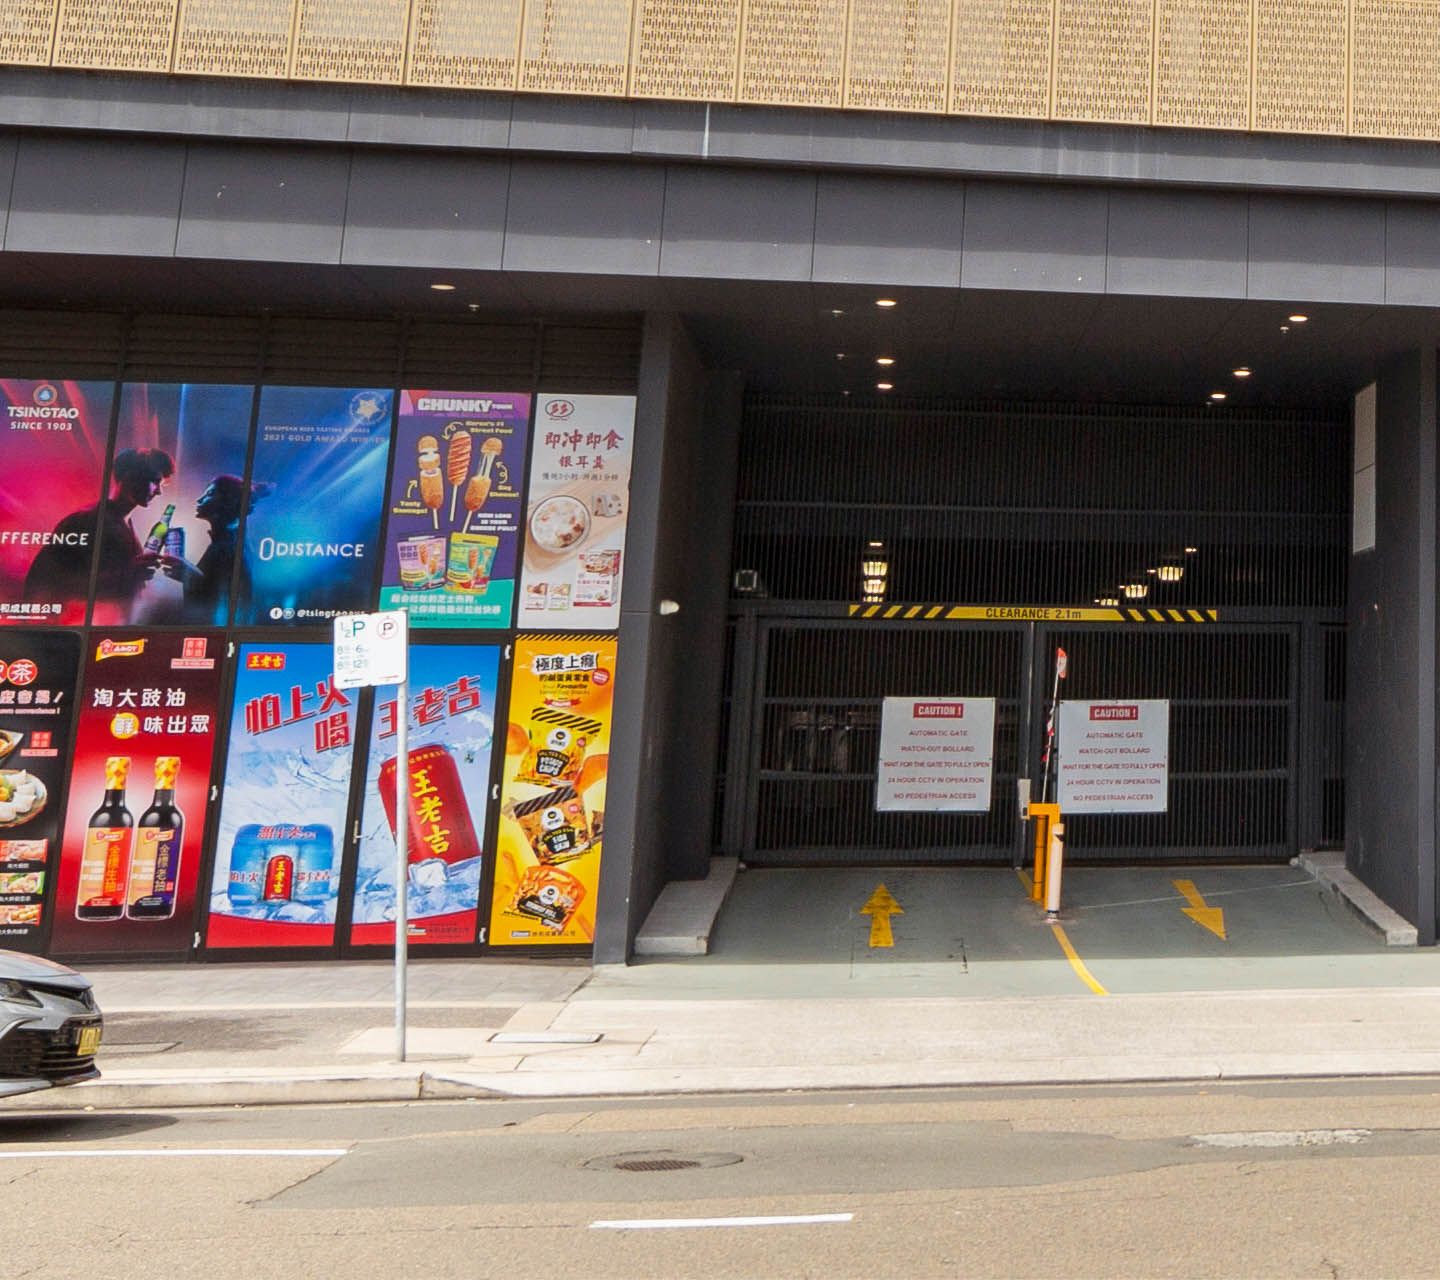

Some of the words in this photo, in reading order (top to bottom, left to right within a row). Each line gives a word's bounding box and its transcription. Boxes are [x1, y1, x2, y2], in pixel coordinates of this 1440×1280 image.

[418, 398, 493, 412] CHUNKY
[7, 406, 79, 419] TSINGTAO
[10, 421, 42, 430] SINCE
[47, 422, 73, 431] 1903
[545, 429, 624, 452] 即冲即食
[986, 608, 1050, 619] CLEARANCE
[1056, 609, 1082, 620] 2.1m
[248, 655, 285, 669] 王老吉
[93, 688, 186, 707] 淘大豉油
[245, 673, 352, 736] 怕上火
[918, 706, 956, 716] CAUTION
[1094, 708, 1131, 718] CAUTION
[114, 714, 210, 734] 鮮味出眾
[313, 711, 352, 753] 喝
[942, 745, 975, 753] BOLLARD
[894, 792, 904, 800] NO
[906, 792, 947, 800] PEDESTRIAN
[949, 792, 976, 800] ACCESS
[410, 768, 452, 855] 王老吉
